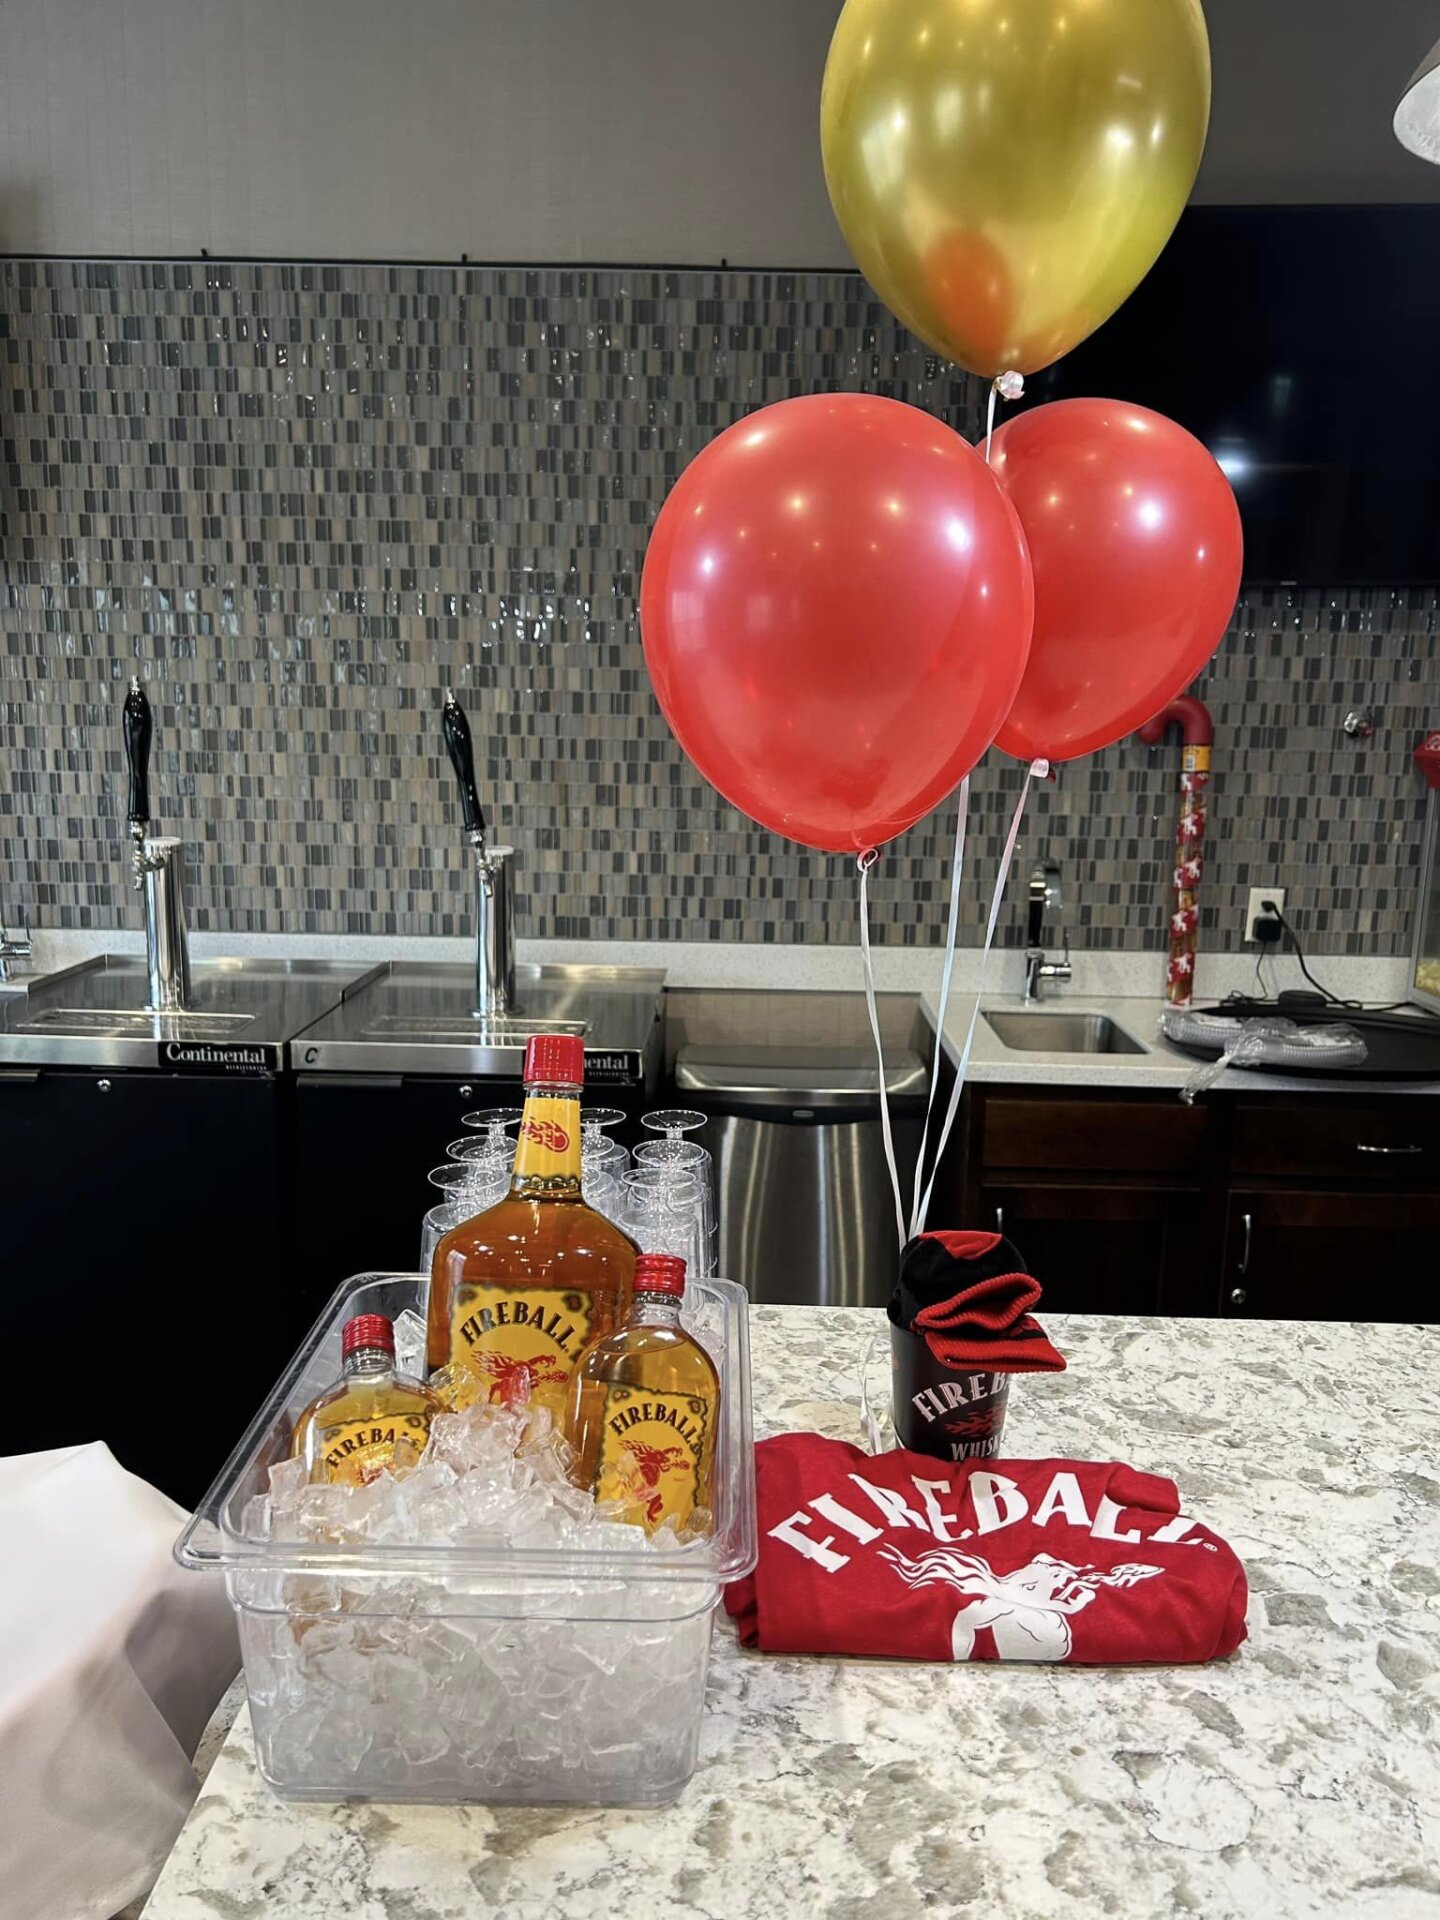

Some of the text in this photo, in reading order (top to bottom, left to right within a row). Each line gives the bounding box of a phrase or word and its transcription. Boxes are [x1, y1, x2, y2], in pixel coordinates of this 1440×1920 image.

[166, 1042, 266, 1064] Continental
[305, 1047, 318, 1064] C
[460, 1300, 575, 1351] FIREBALL
[912, 1371, 1008, 1423] FIREB
[609, 1403, 698, 1446] FIREBALL
[325, 1427, 421, 1469] FIREBA
